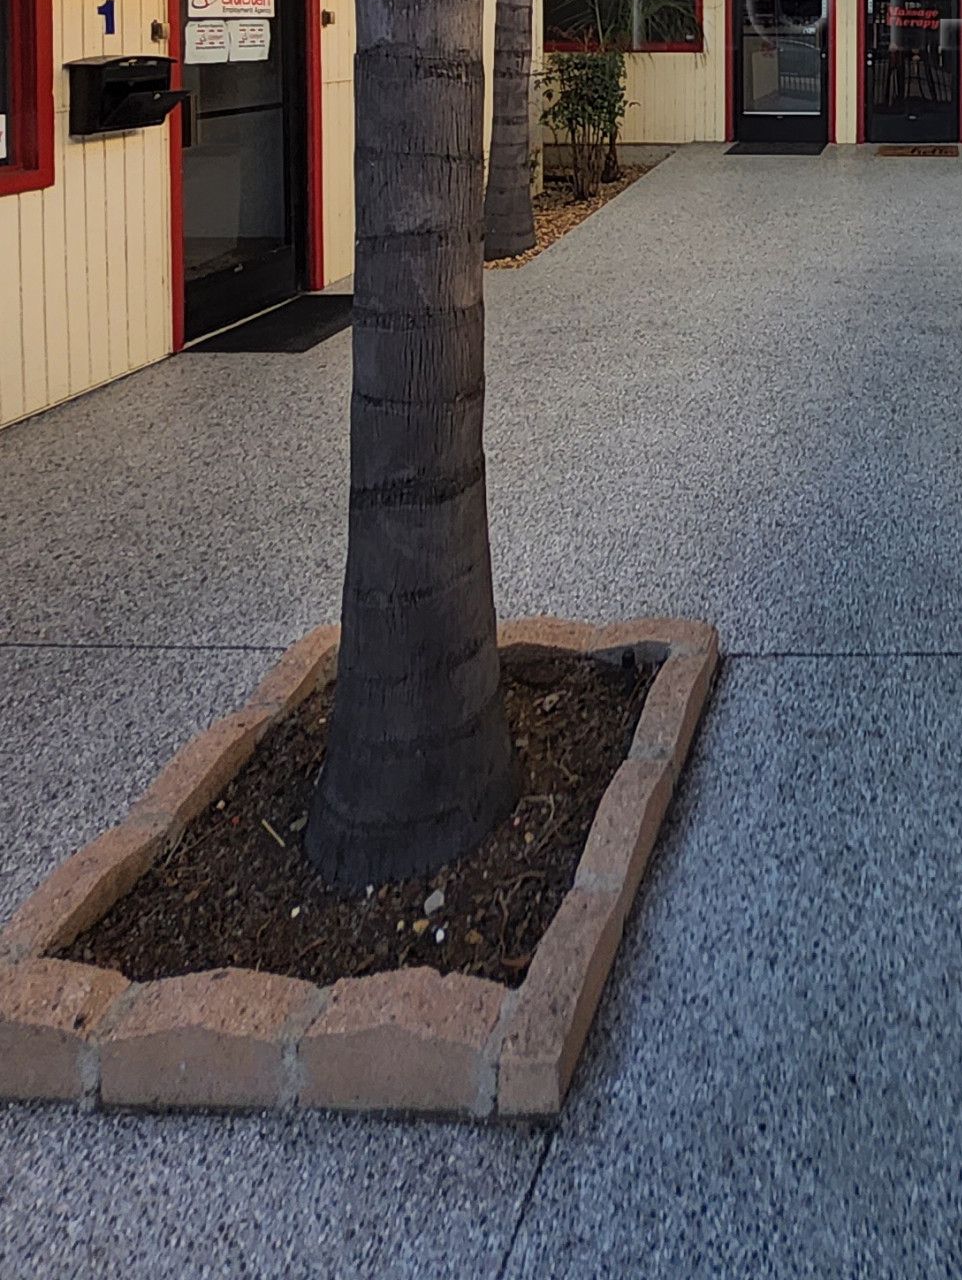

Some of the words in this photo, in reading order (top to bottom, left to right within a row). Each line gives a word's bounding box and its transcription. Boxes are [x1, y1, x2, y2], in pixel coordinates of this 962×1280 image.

[97, 0, 115, 35] 1
[886, 5, 939, 19] Massage
[886, 16, 940, 31] Therapy
